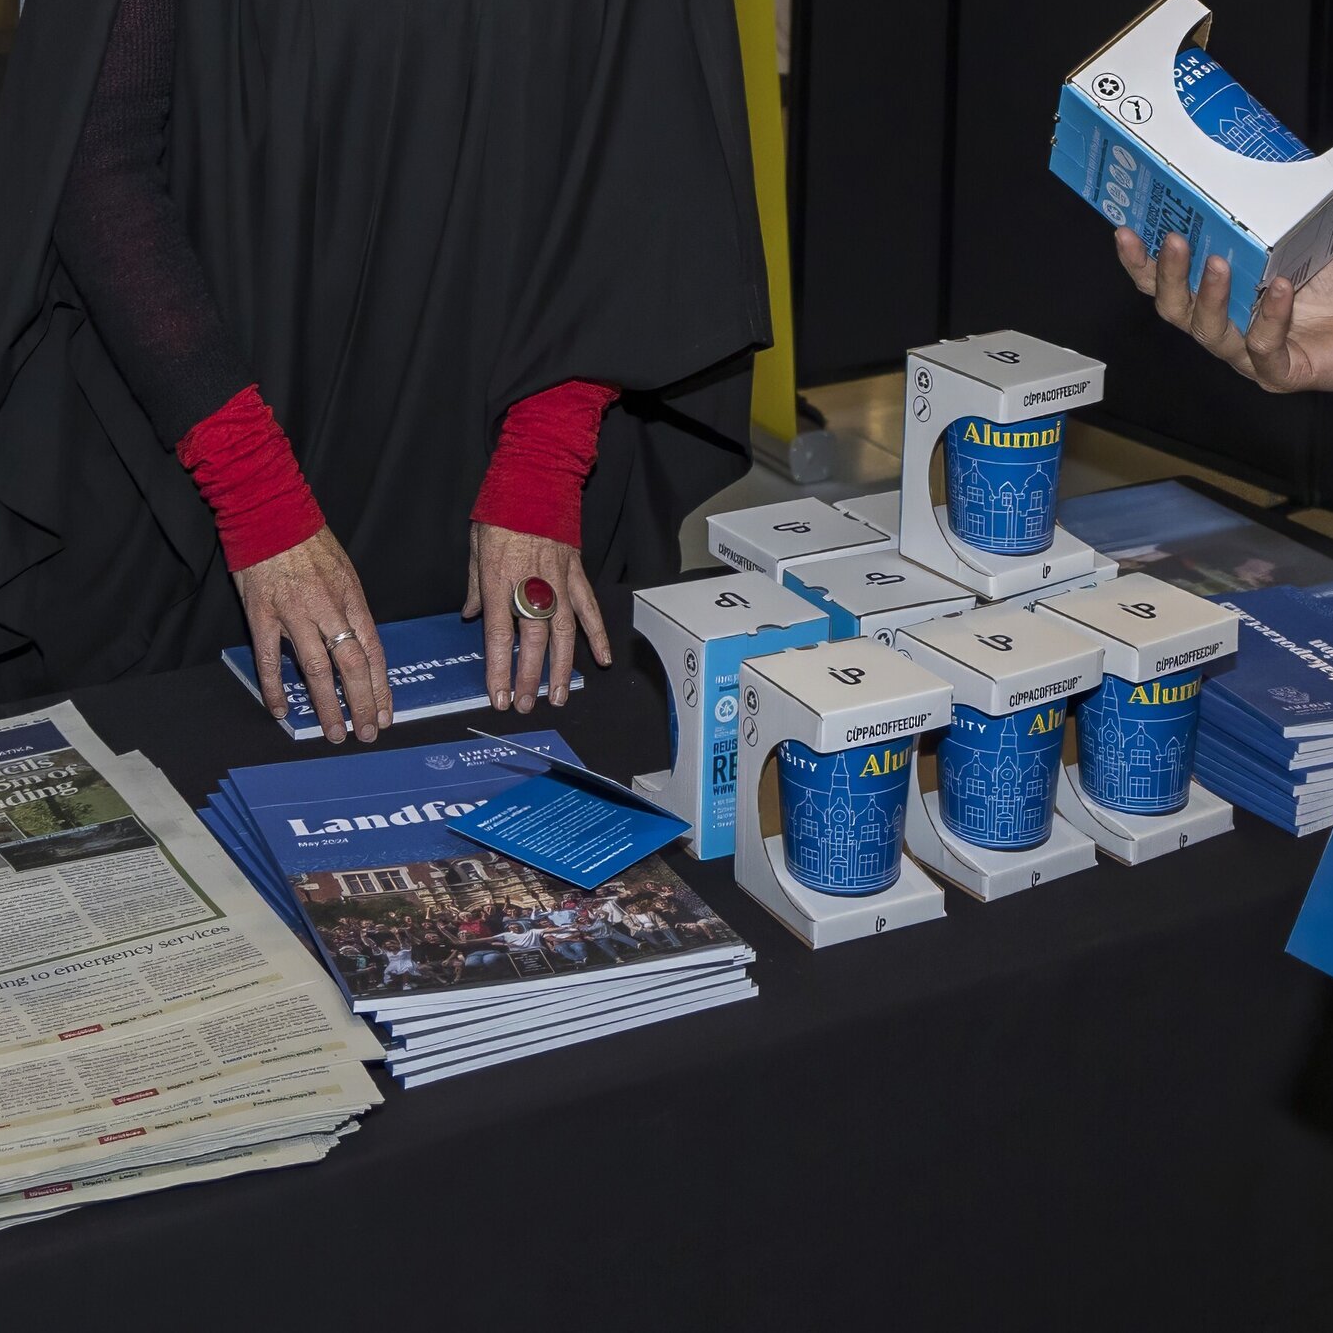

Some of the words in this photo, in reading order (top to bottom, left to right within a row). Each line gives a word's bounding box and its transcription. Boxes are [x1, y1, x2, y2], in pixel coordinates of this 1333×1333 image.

[963, 420, 1061, 449] Alumni
[48, 763, 80, 780] of
[298, 839, 320, 849] May
[322, 837, 349, 846] 2024
[31, 968, 51, 982] to
[54, 942, 155, 977] emergency
[156, 923, 231, 950] services
